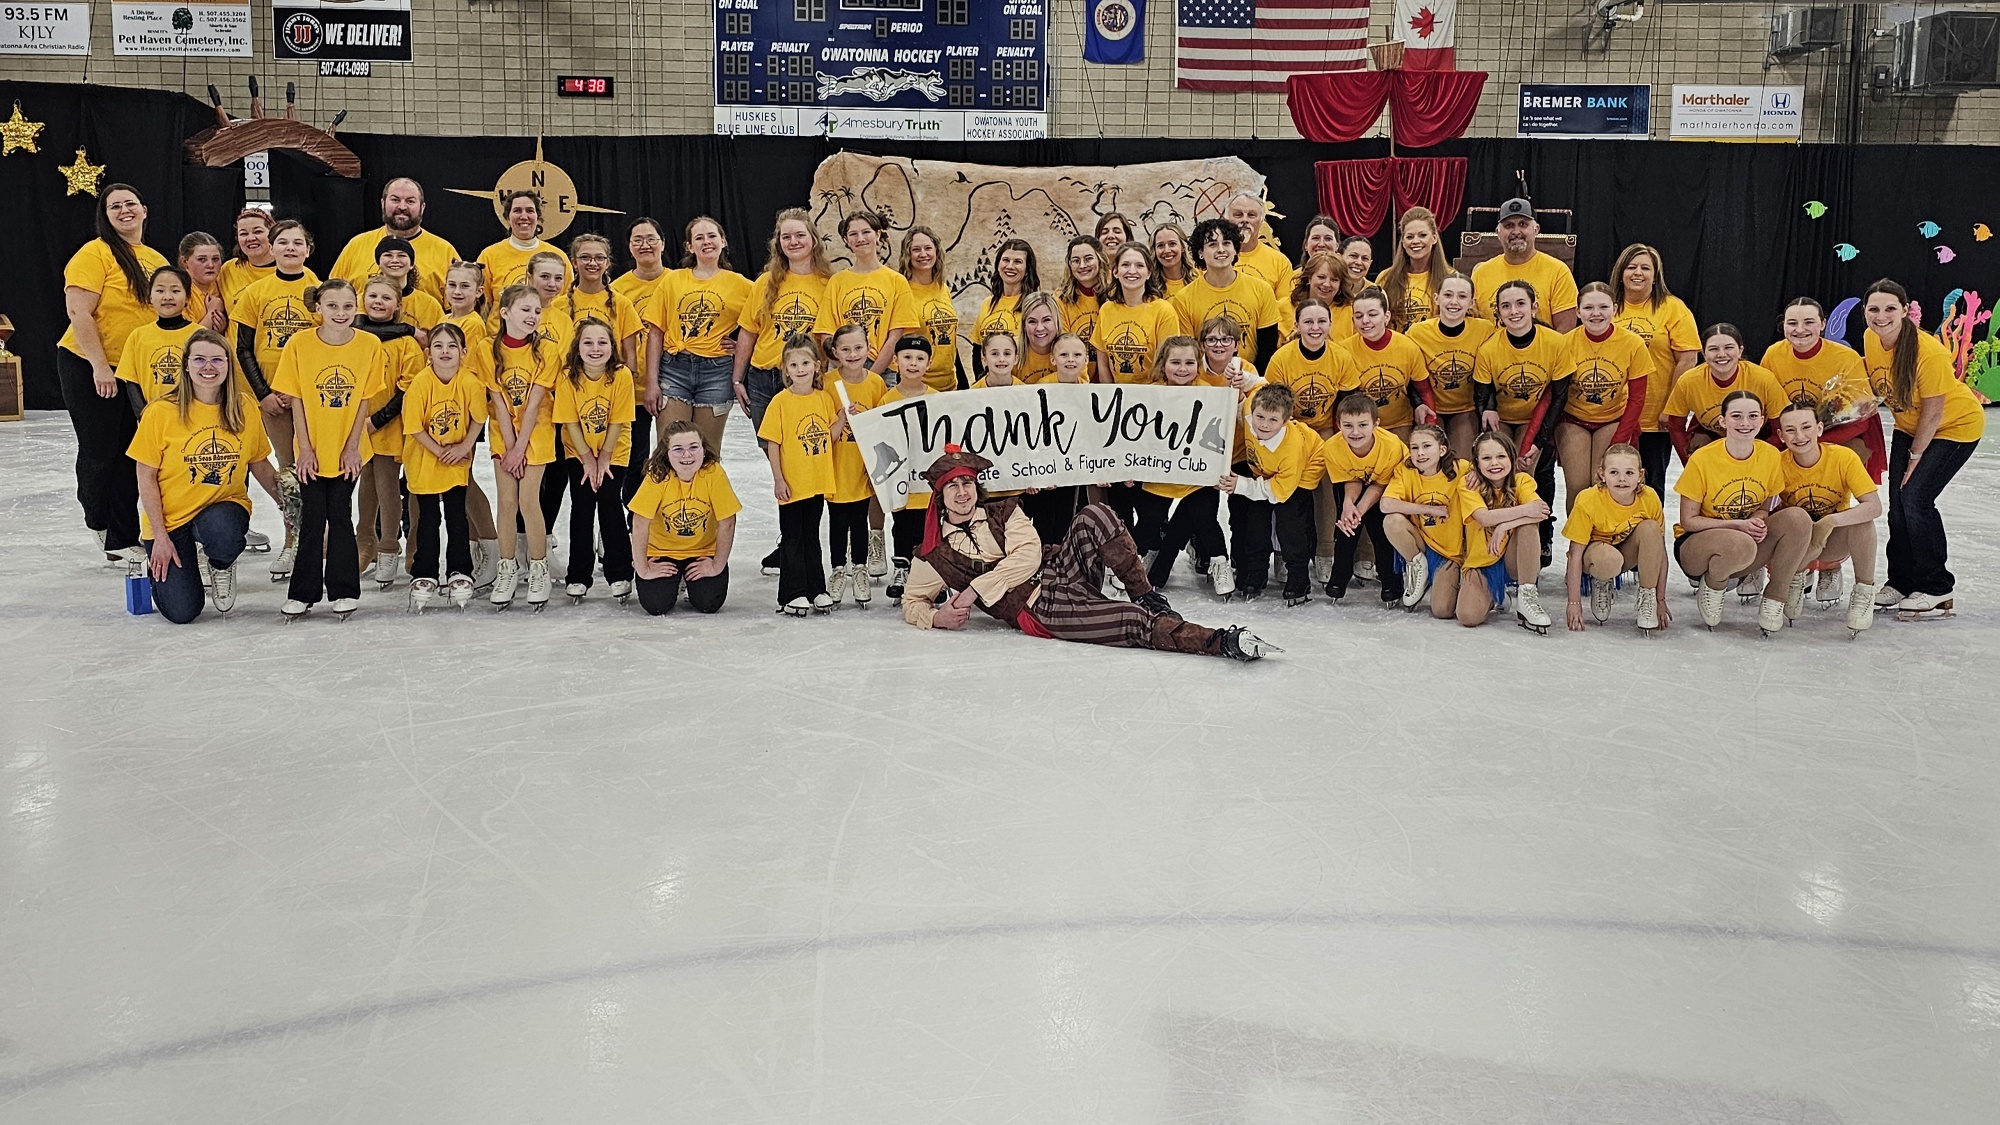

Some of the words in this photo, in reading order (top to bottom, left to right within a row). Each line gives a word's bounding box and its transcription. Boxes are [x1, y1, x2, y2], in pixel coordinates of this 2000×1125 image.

[718, 0, 732, 9] ON
[735, 0, 759, 10] GOAL
[1003, 5, 1017, 15] ON
[1019, 5, 1043, 16] GOAL
[4, 7, 40, 21] 93.5
[44, 8, 69, 21] FM
[284, 15, 301, 34] JIMMY
[890, 22, 924, 34] PERIOD
[18, 25, 56, 42] KJLY
[118, 34, 137, 44] Pet
[139, 34, 172, 45] Haven
[325, 23, 346, 46] WE
[346, 24, 403, 47] DELIVER!
[720, 40, 754, 52] PLAYER
[770, 42, 810, 53] PENALTY
[945, 45, 979, 57] PLAYER
[996, 47, 1036, 58] PENALTY
[821, 47, 889, 63] OWATONNA
[894, 49, 942, 64] HOCKEY
[320, 61, 370, 76] 507-413-0999
[574, 78, 606, 93] 4:38
[1523, 96, 1582, 109] BREMER
[1586, 97, 1629, 109] BANK
[1682, 93, 1751, 106] Marthaler
[734, 111, 777, 122] HUSKIES
[973, 116, 1013, 127] OWATONNA
[1014, 117, 1038, 127] YOUTH
[716, 123, 740, 134] BLUE
[744, 124, 766, 134] LINE
[770, 125, 795, 135] CLUB
[1679, 120, 1794, 130] marthalerhonda.com
[966, 128, 996, 139] HOCKEY
[998, 129, 1045, 139] ASSOCIATION
[245, 161, 269, 171] OO
[253, 171, 263, 185] 3
[531, 170, 545, 187] N
[558, 195, 571, 213] E
[882, 388, 1078, 456] Thank
[1091, 387, 1204, 457] You!
[978, 468, 1000, 481] ate
[1011, 459, 1057, 477] School
[1064, 457, 1074, 472] &
[1079, 454, 1116, 474] Figure
[1124, 453, 1172, 473] Skating
[1178, 456, 1207, 472] Club
